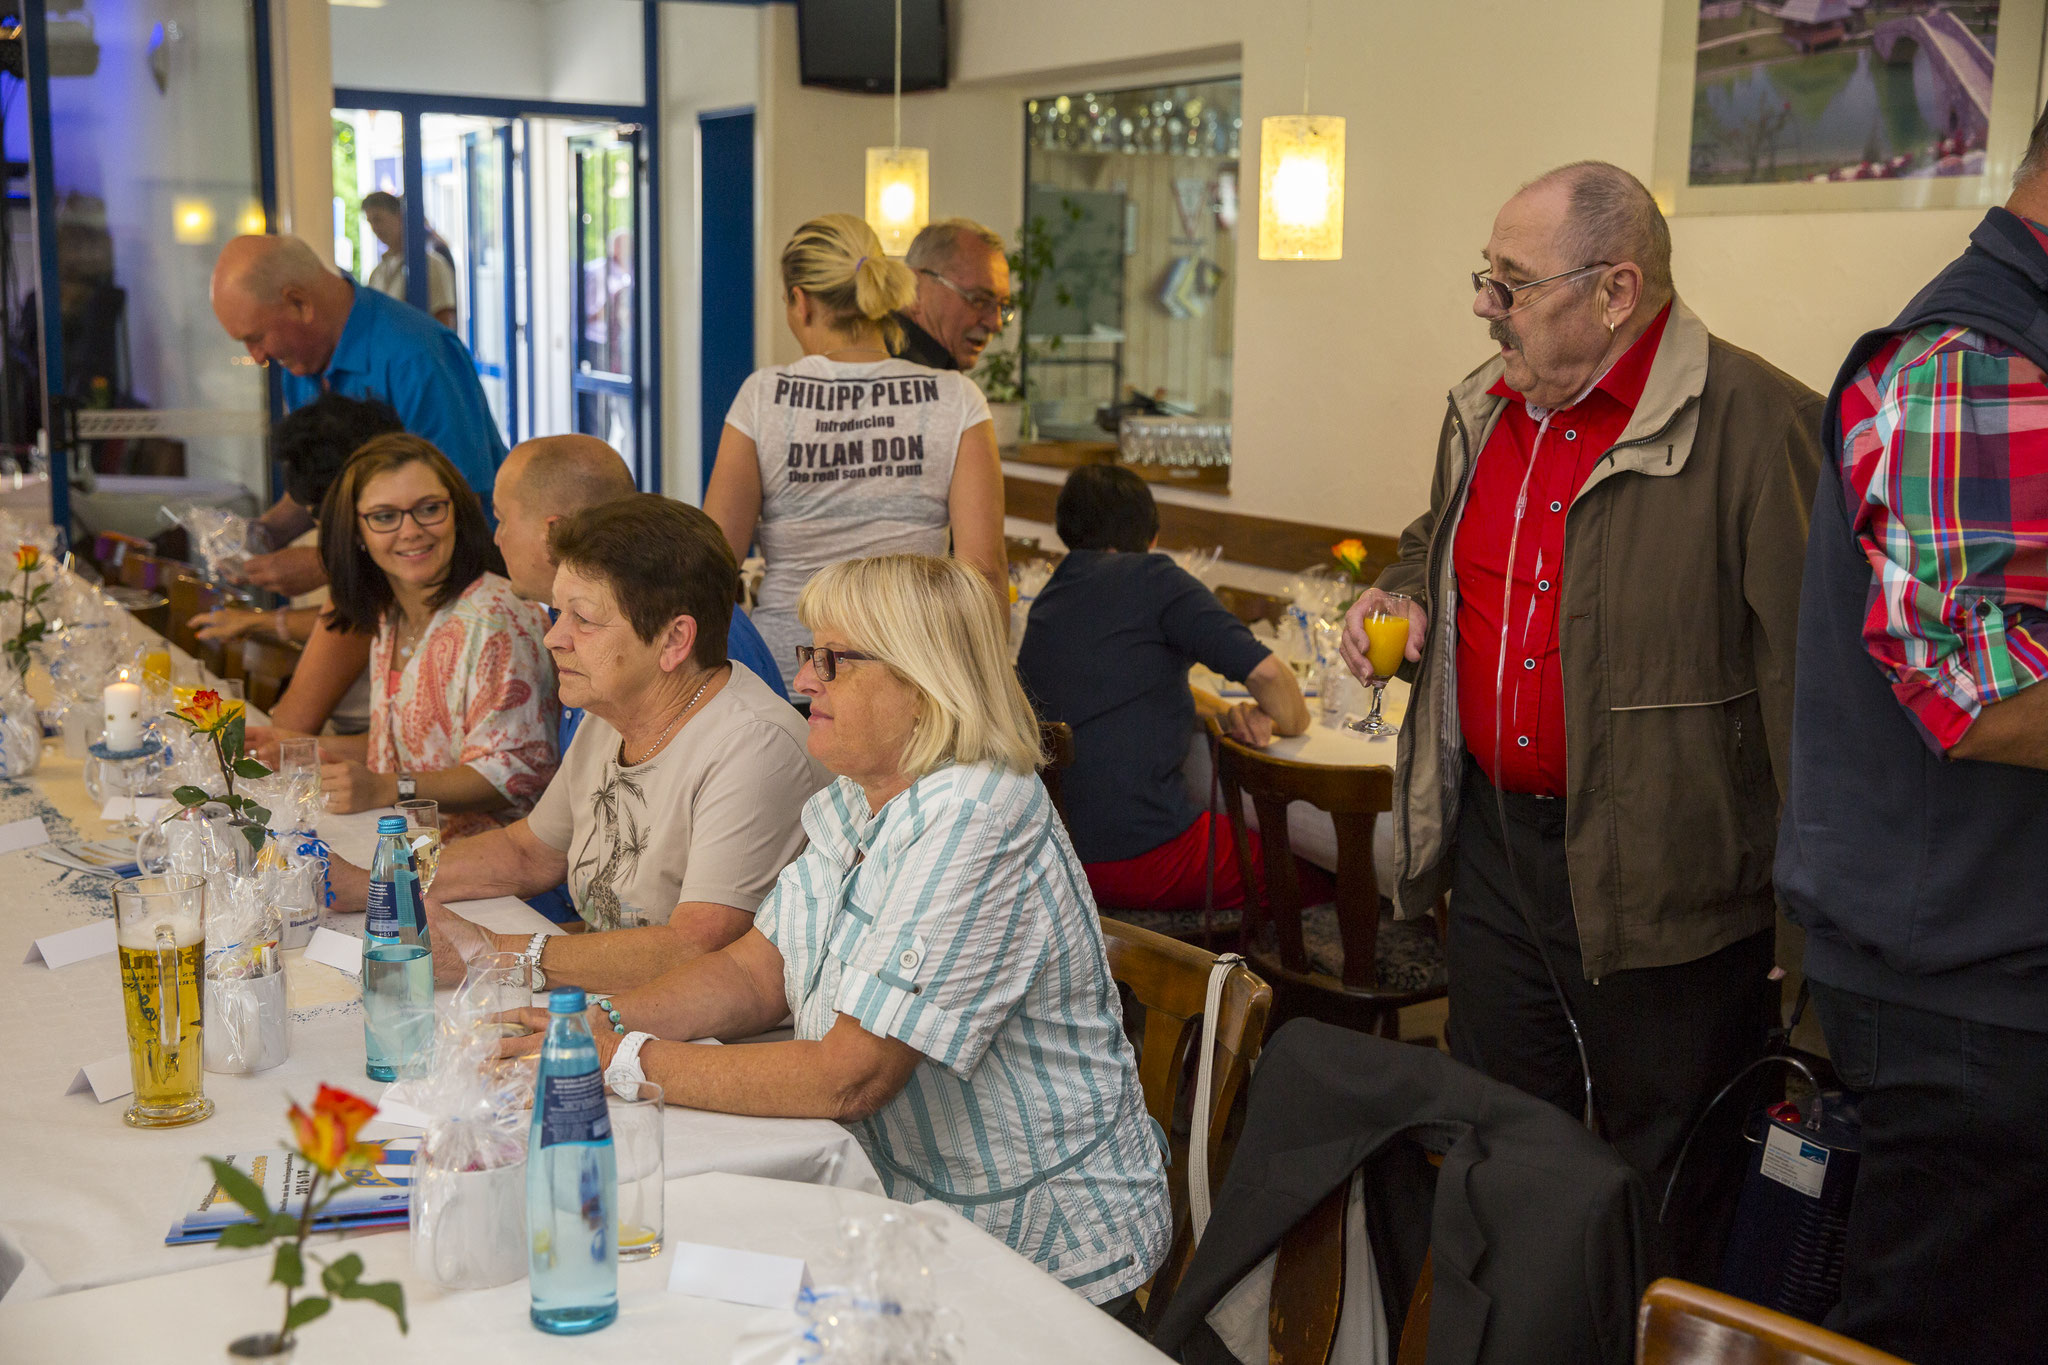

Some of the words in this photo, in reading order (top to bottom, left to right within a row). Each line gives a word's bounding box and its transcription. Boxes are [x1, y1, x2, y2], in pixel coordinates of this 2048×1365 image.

[774, 379, 865, 411] PHILIPP
[872, 380, 939, 407] PLEIN
[815, 414, 895, 432] introducing
[787, 440, 864, 468] DYLAN
[872, 435, 924, 462] DON
[789, 470, 810, 483] the
[812, 468, 839, 483] real
[842, 467, 866, 479] son
[869, 465, 882, 478] of
[885, 465, 893, 476] a
[896, 464, 922, 478] gun
[295, 1170, 310, 1195] 2016/17
